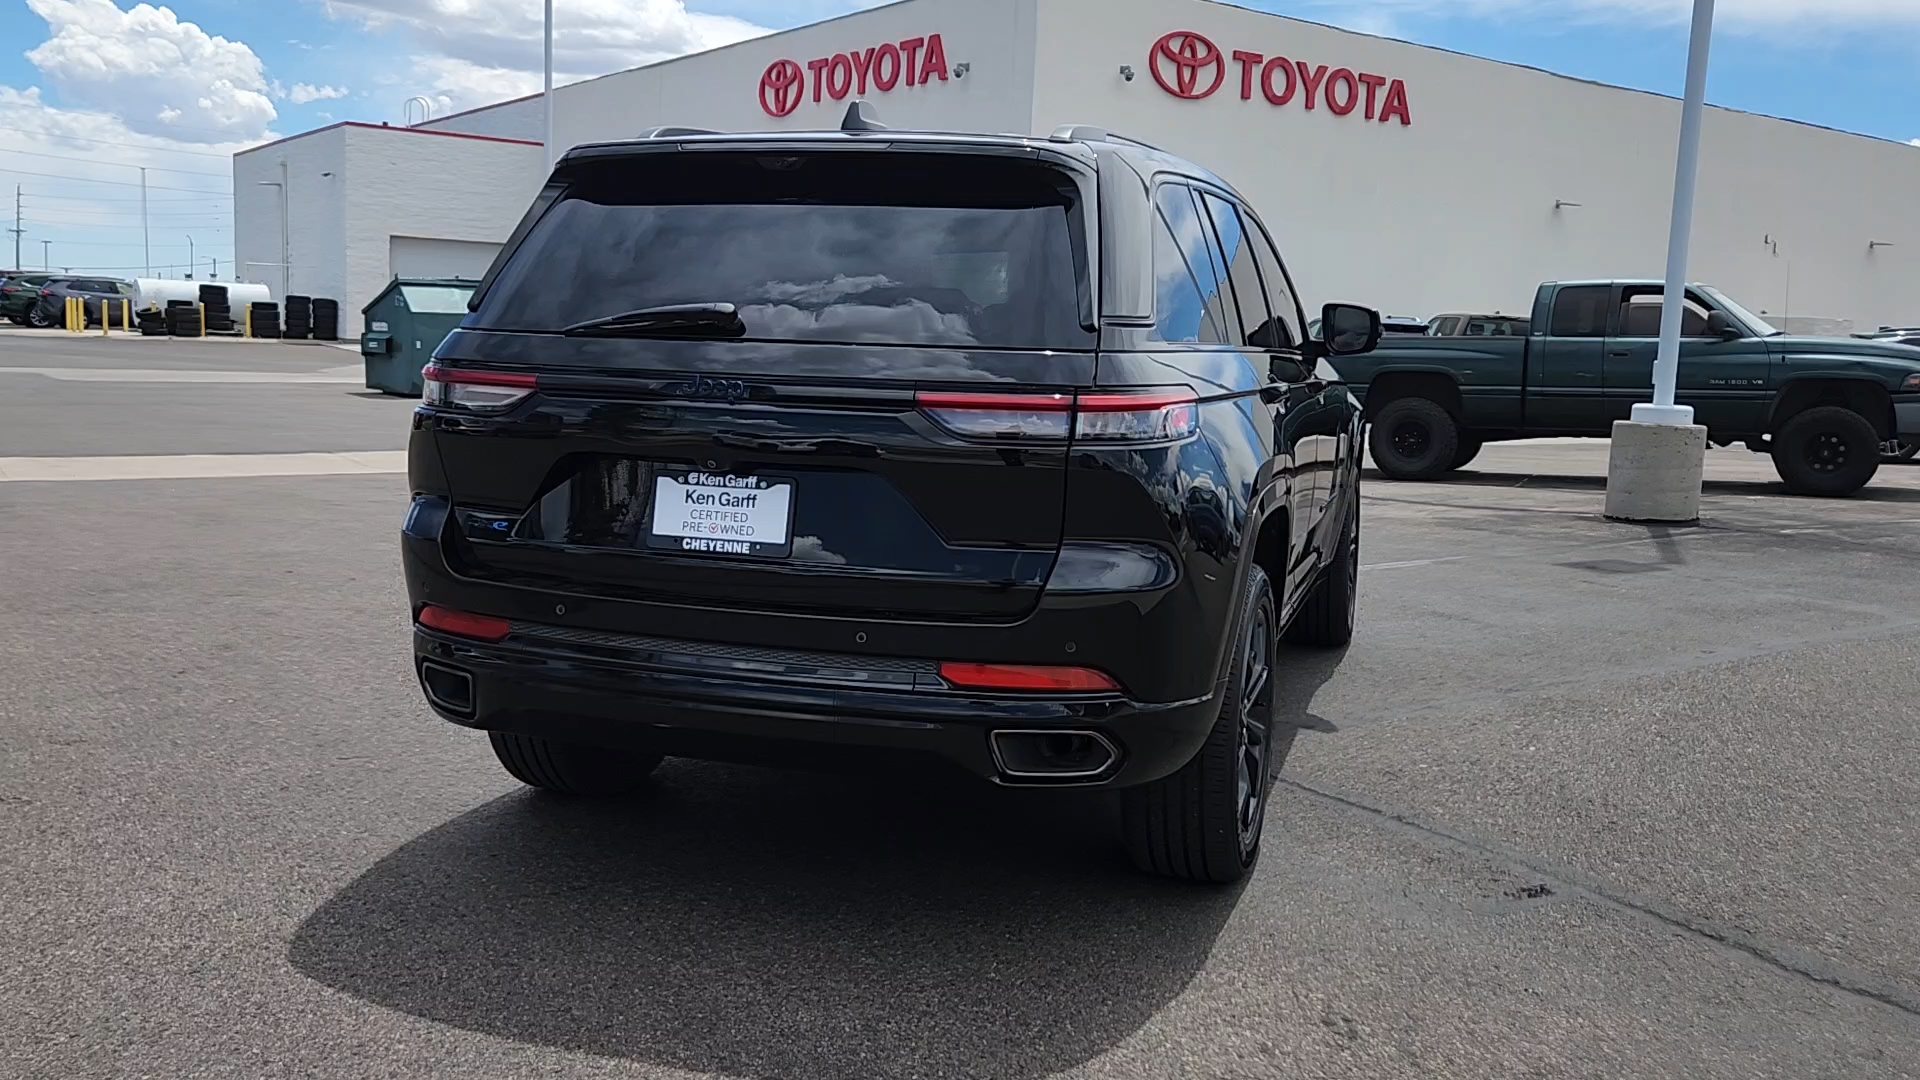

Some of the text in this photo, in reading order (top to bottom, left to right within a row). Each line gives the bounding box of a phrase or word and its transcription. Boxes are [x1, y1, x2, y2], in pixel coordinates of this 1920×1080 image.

[808, 33, 948, 102] TOYOTA
[1232, 50, 1411, 126] TOYOTA
[682, 374, 744, 405] Jeep
[700, 473, 724, 486] Ken
[725, 474, 758, 489] Garff
[684, 489, 758, 509] Ken Garff
[690, 509, 749, 523] CERTIFIED
[682, 538, 751, 554] CHEYENNE
